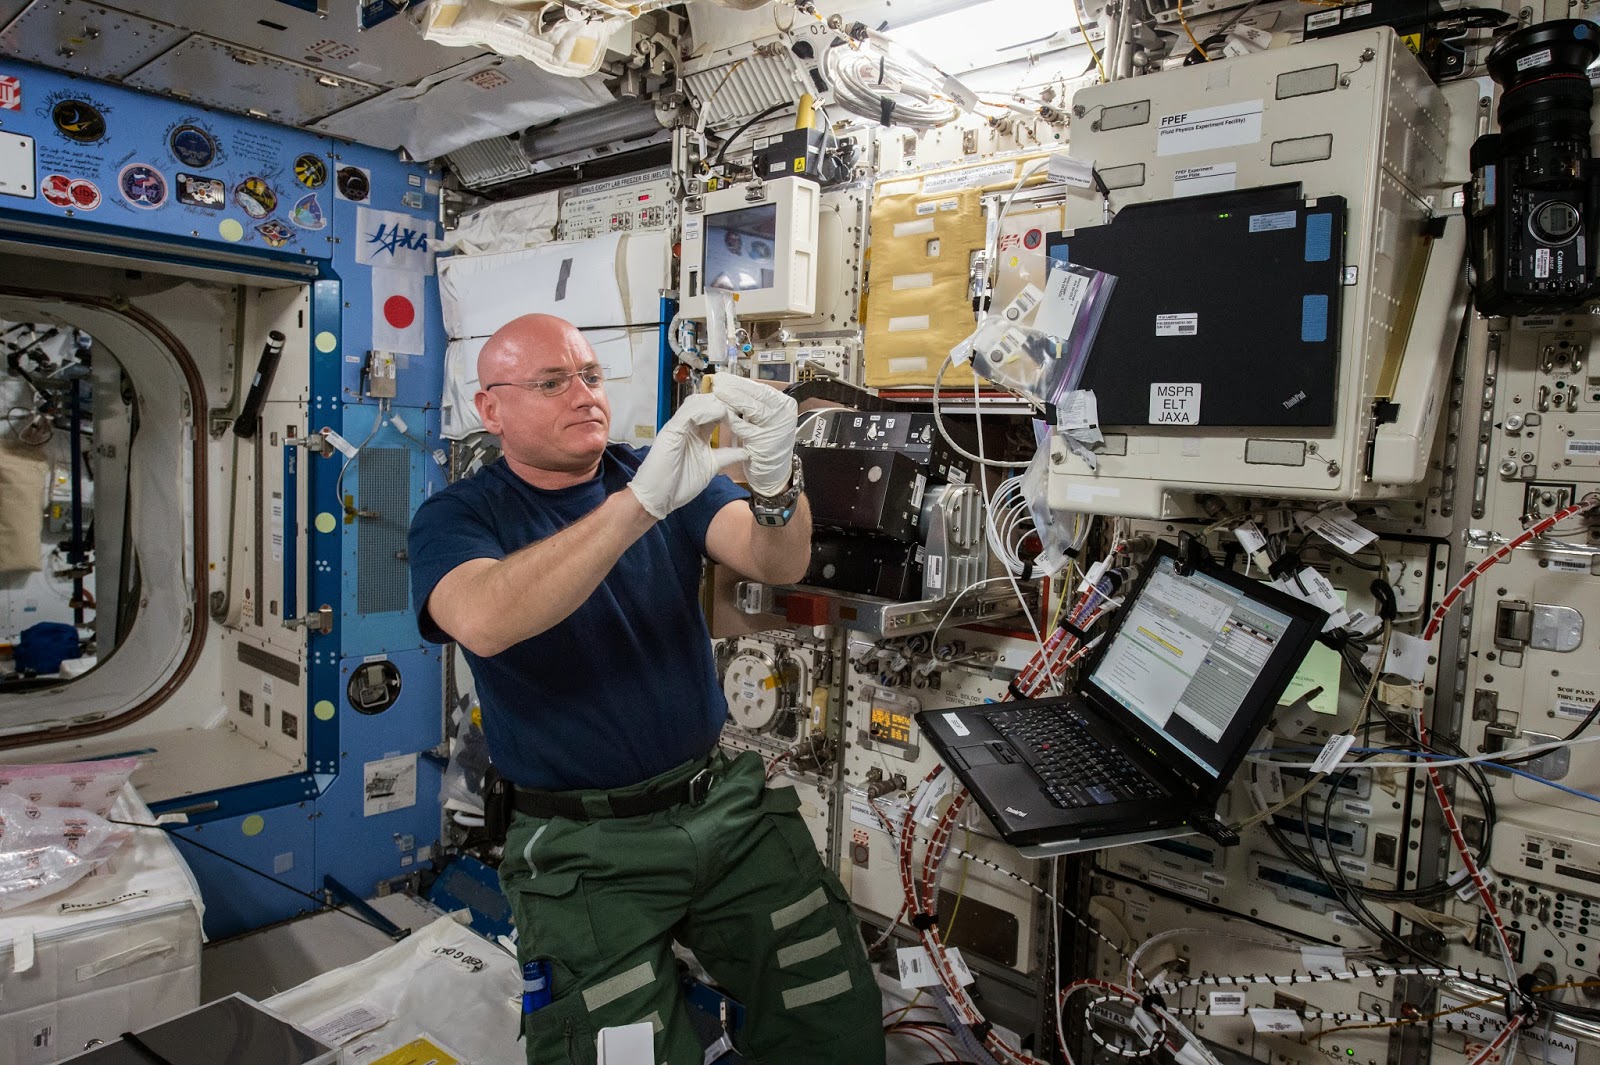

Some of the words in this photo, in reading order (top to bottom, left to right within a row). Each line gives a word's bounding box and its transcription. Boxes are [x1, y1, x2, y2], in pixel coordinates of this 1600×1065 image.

[1162, 114, 1187, 126] FPEF
[582, 186, 594, 194] MINUS
[595, 182, 611, 191] EIGHTY
[621, 177, 641, 186] FREEZER
[651, 170, 670, 180] (MELFI)
[364, 223, 427, 258] JAXA
[1158, 386, 1194, 397] MSPR
[1164, 399, 1186, 409] ELT
[1282, 390, 1306, 410] ThinkPad
[1158, 412, 1190, 422] JAXA
[960, 694, 980, 702] BIOLOGY
[1005, 806, 1028, 818] ThinkPad
[454, 950, 463, 959] G
[1482, 1016, 1497, 1026] AIR
[1547, 1039, 1574, 1053] (AAA)
[1319, 1047, 1343, 1062] RACK
